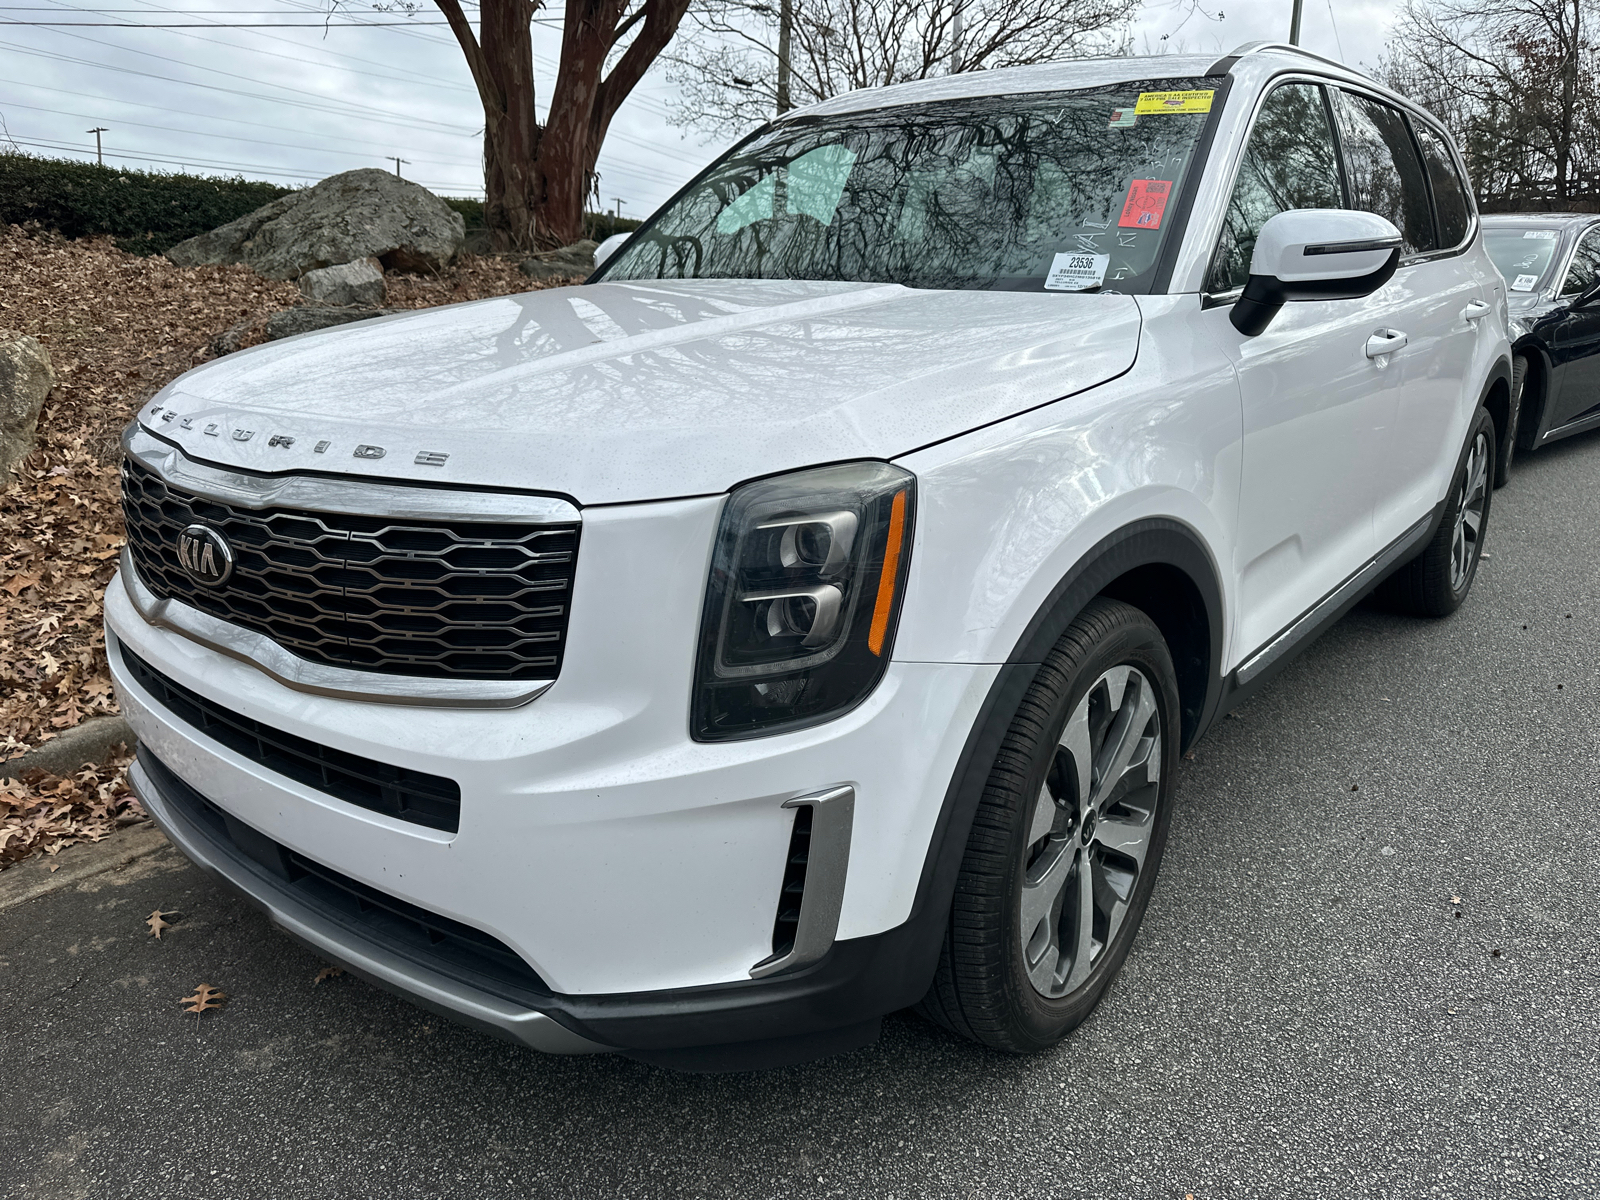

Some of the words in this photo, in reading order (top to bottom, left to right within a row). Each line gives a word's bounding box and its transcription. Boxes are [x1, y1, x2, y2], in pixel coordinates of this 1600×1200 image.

[1130, 186, 1138, 204] Nissan
[1069, 256, 1095, 269] 23536
[150, 404, 450, 467] TELLURIDE
[181, 534, 218, 576] KIA
